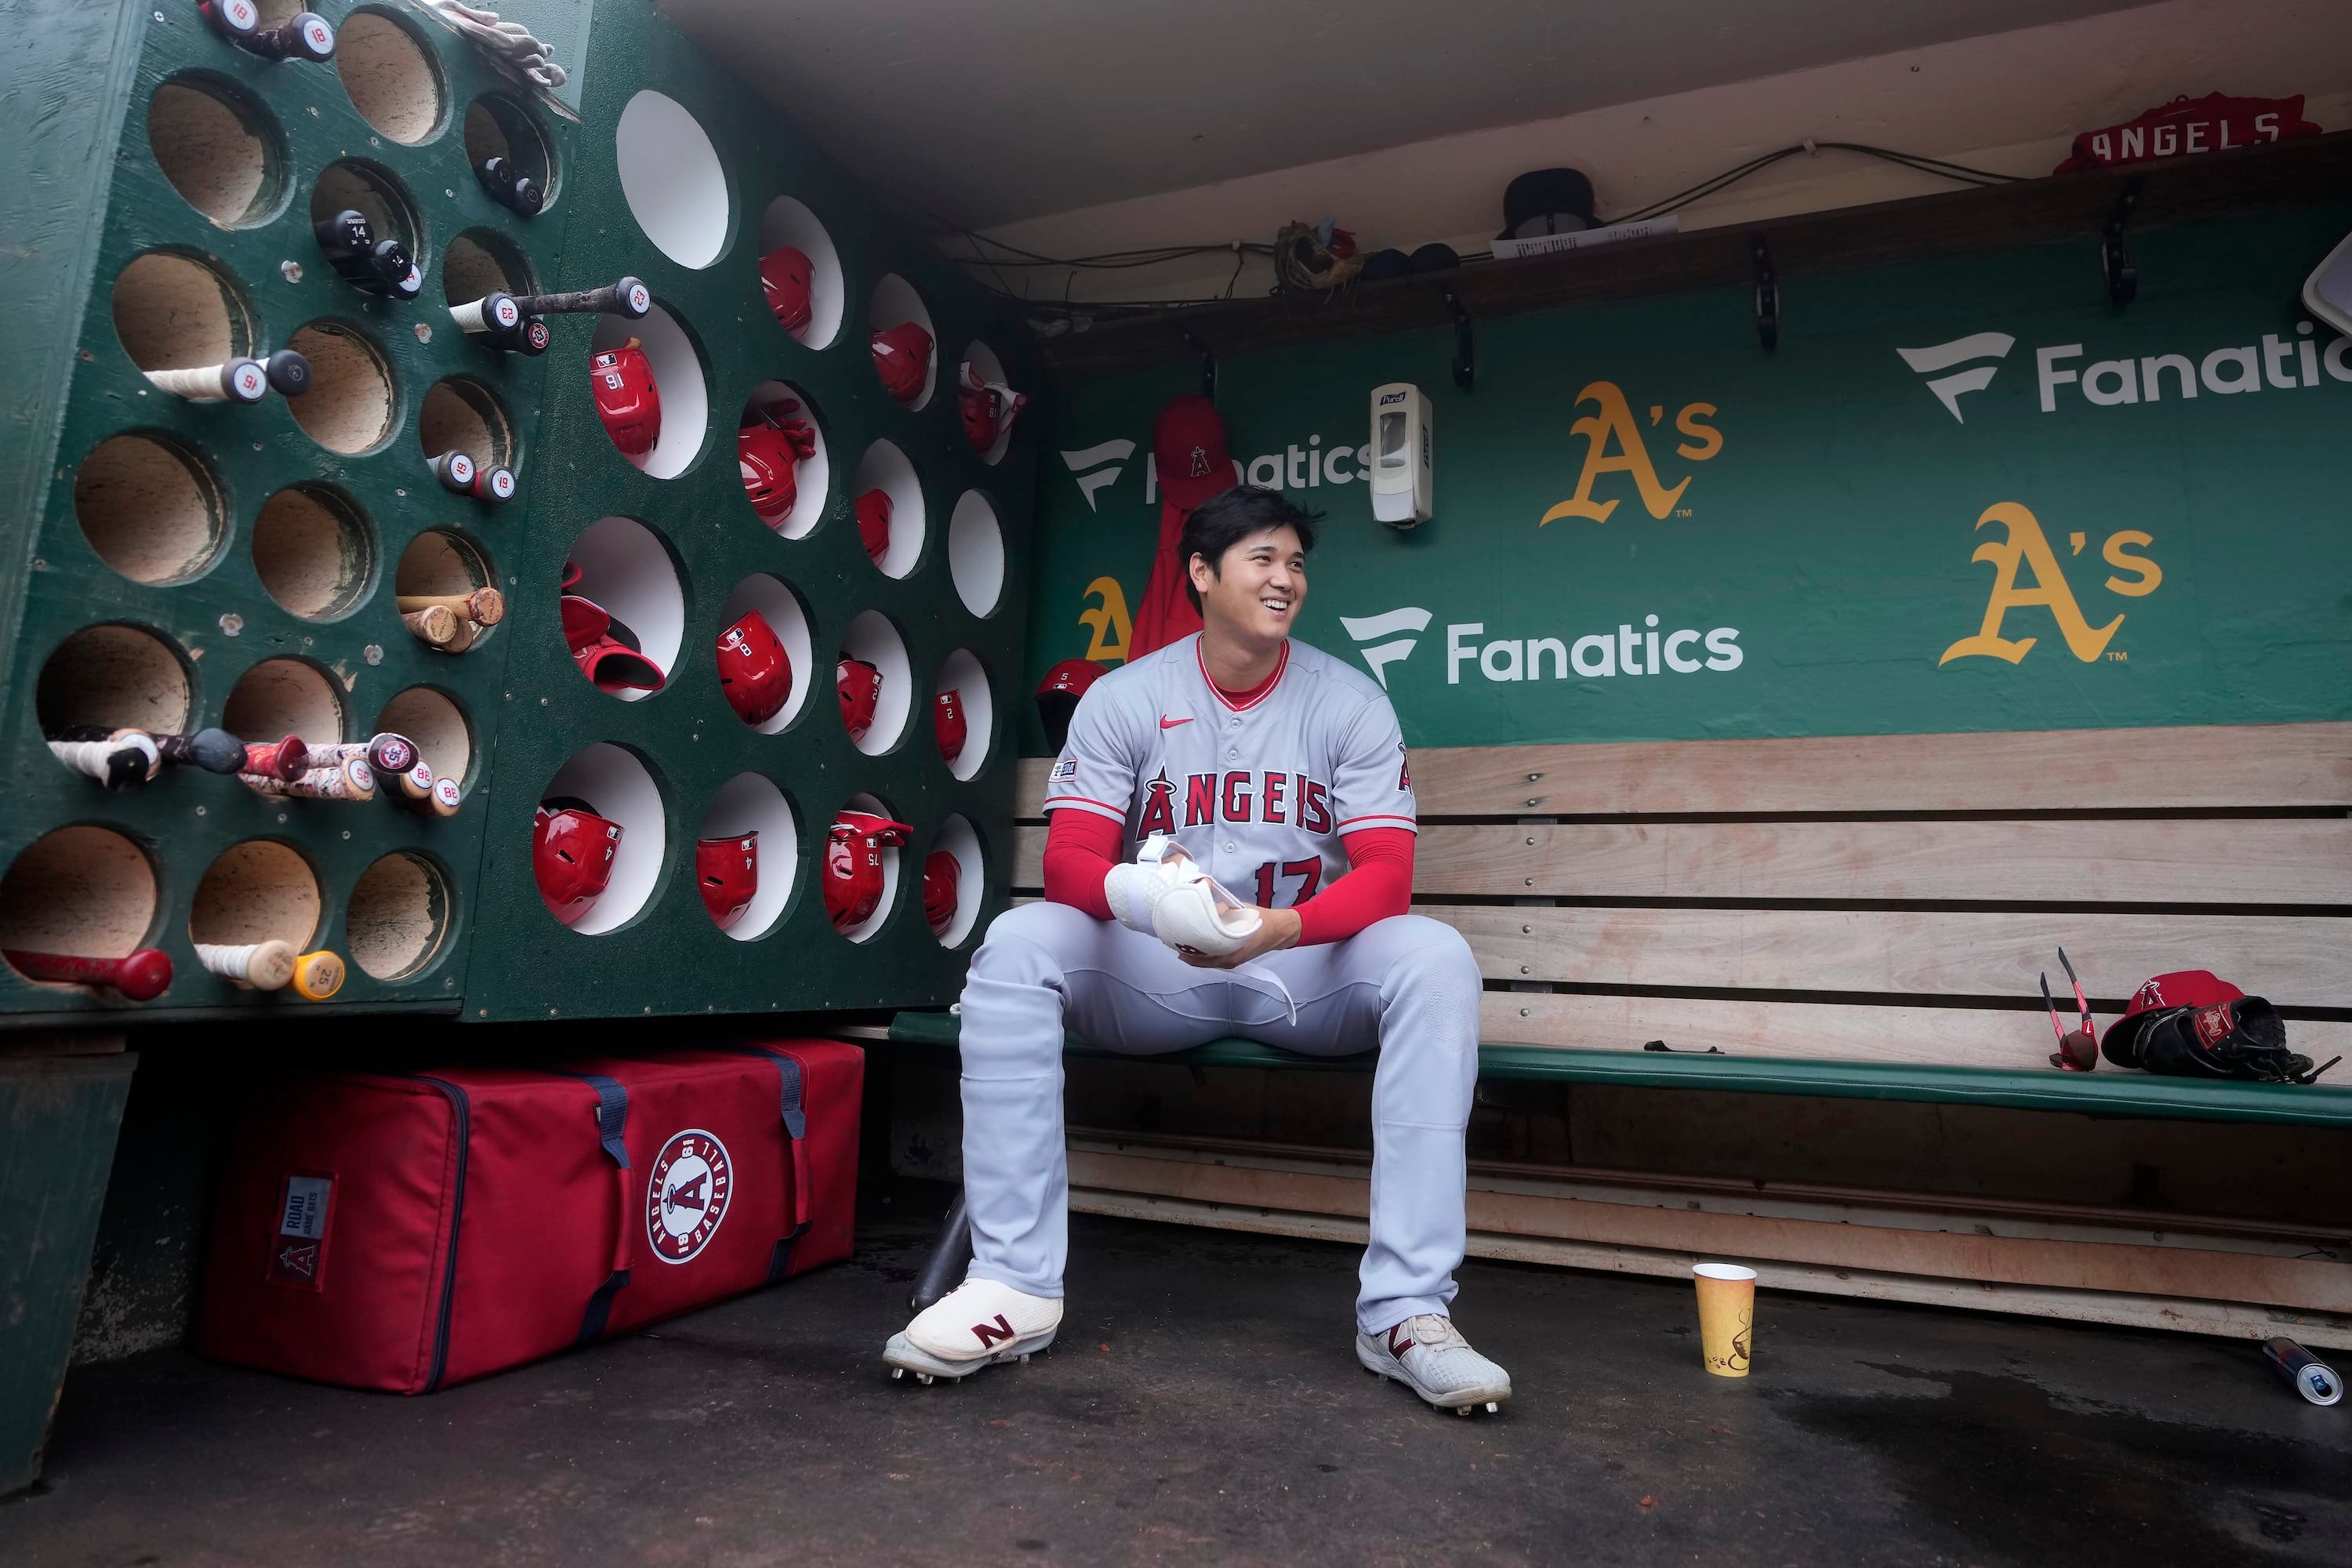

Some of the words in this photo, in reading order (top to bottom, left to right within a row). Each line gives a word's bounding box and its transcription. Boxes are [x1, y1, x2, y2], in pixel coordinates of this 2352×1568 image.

[232, 3, 249, 20] 18
[311, 28, 326, 43] 18
[2092, 112, 2279, 162] ANGELS
[352, 226, 366, 238] 14
[633, 289, 645, 307] 23
[604, 373, 624, 390] 16
[1383, 394, 1403, 403] Purell
[739, 643, 753, 657] 8
[1446, 613, 1744, 685] Fanatics
[1060, 673, 1069, 681] 5
[1254, 854, 1323, 909] 17
[318, 968, 332, 985] 25
[695, 1141, 726, 1244] BASEBALL
[651, 1160, 668, 1245] ANGELS
[286, 1196, 304, 1229] ROAD
